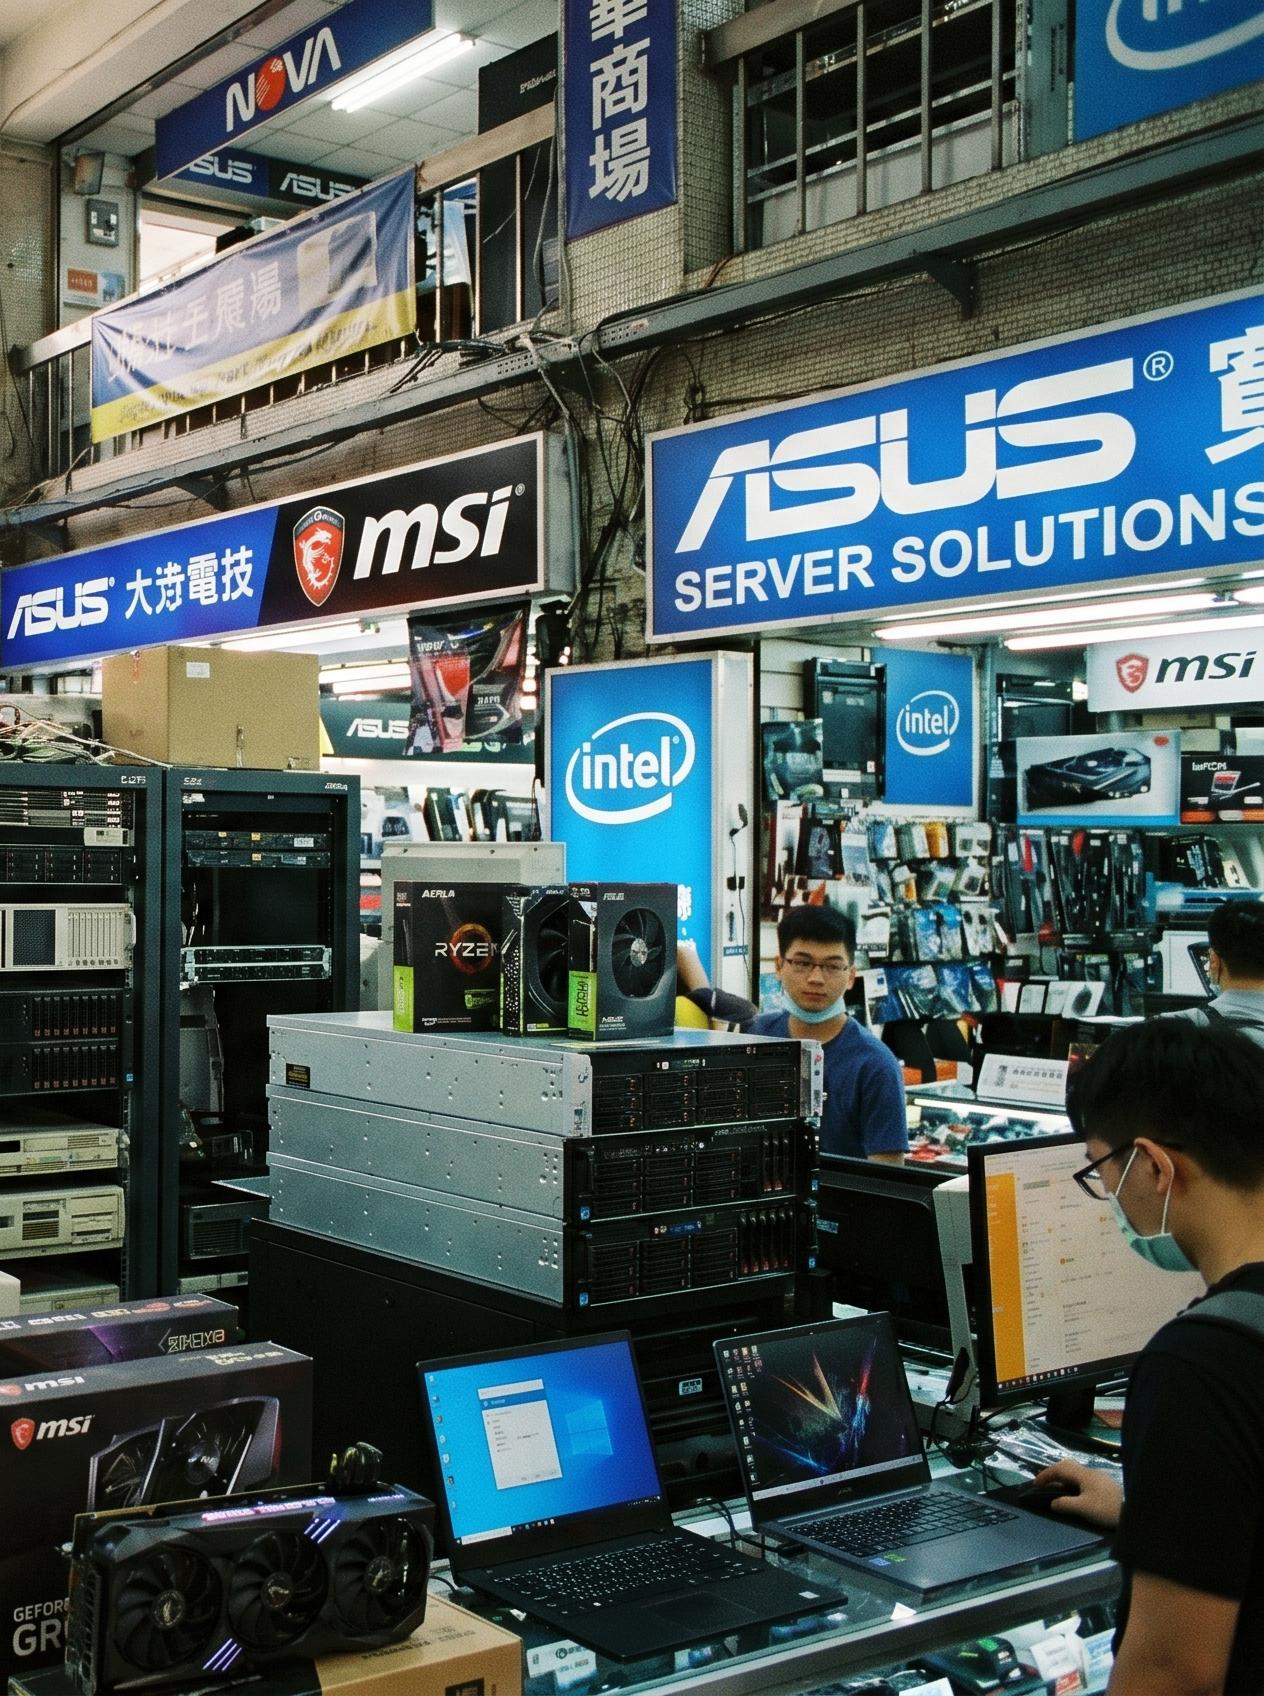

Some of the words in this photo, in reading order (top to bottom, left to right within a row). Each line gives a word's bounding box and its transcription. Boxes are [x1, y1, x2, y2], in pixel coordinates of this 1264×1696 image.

[226, 26, 342, 133] NOVA
[675, 357, 1137, 554] ASUS
[353, 485, 513, 580] msi
[674, 545, 875, 612] SERVER
[891, 482, 1264, 583] SOLUTIONS
[6, 576, 110, 640] ASUS
[1154, 651, 1258, 684] msi
[346, 718, 410, 739] ASUS
[905, 703, 949, 735] intel
[582, 736, 671, 790] intel
[36, 1415, 93, 1441] msi
